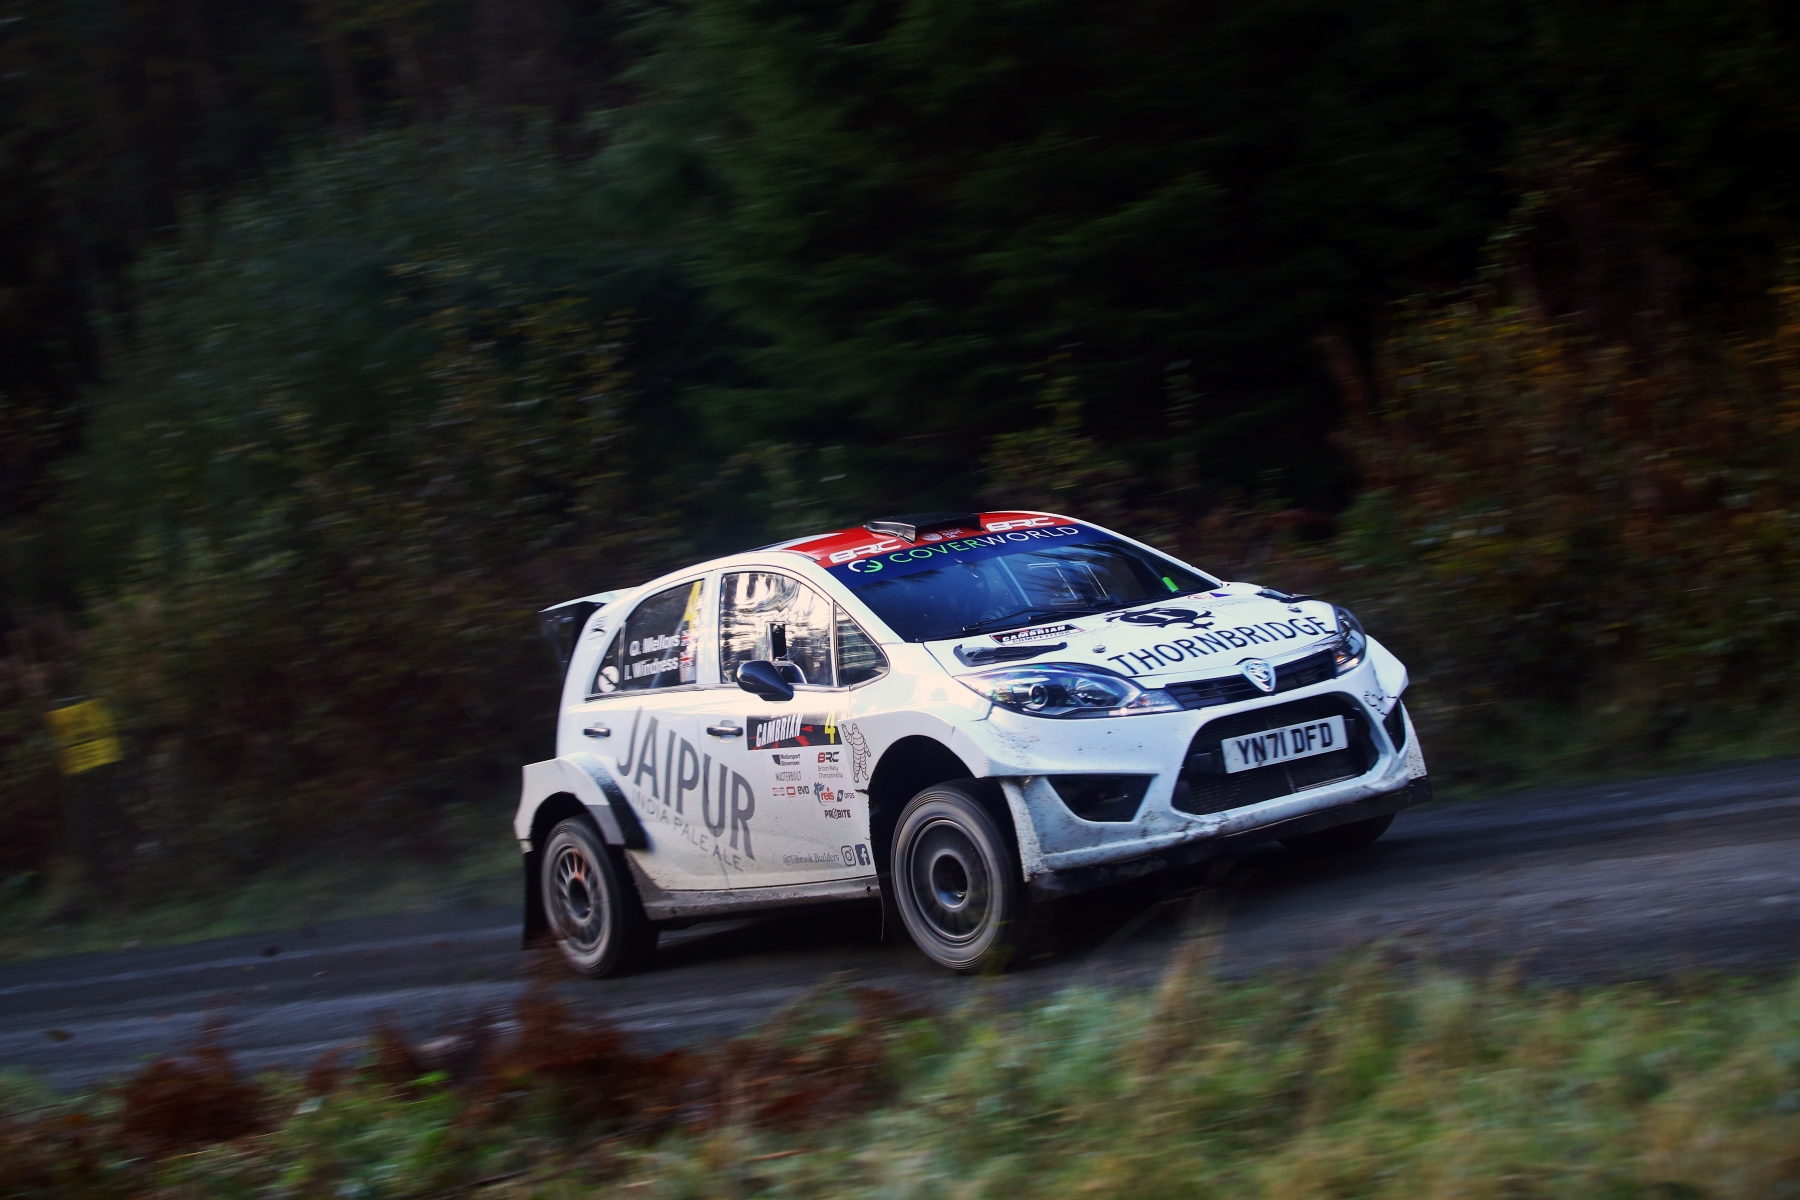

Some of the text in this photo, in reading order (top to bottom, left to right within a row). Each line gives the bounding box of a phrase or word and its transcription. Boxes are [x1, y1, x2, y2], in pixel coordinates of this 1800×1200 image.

[985, 516, 1055, 532] BRC
[828, 539, 902, 564] BRC
[889, 526, 1079, 563] COVERWORLD
[1002, 625, 1066, 643] CAMBRIAN
[1107, 616, 1337, 676] THORNBRIDGE
[756, 712, 804, 748] CAMBRIAN
[824, 708, 837, 744] 4
[1290, 722, 1333, 755] DFD
[817, 751, 840, 763] BRC
[617, 706, 756, 861] JAIPUR
[673, 816, 708, 851] PALE
[712, 843, 744, 872] ALE
